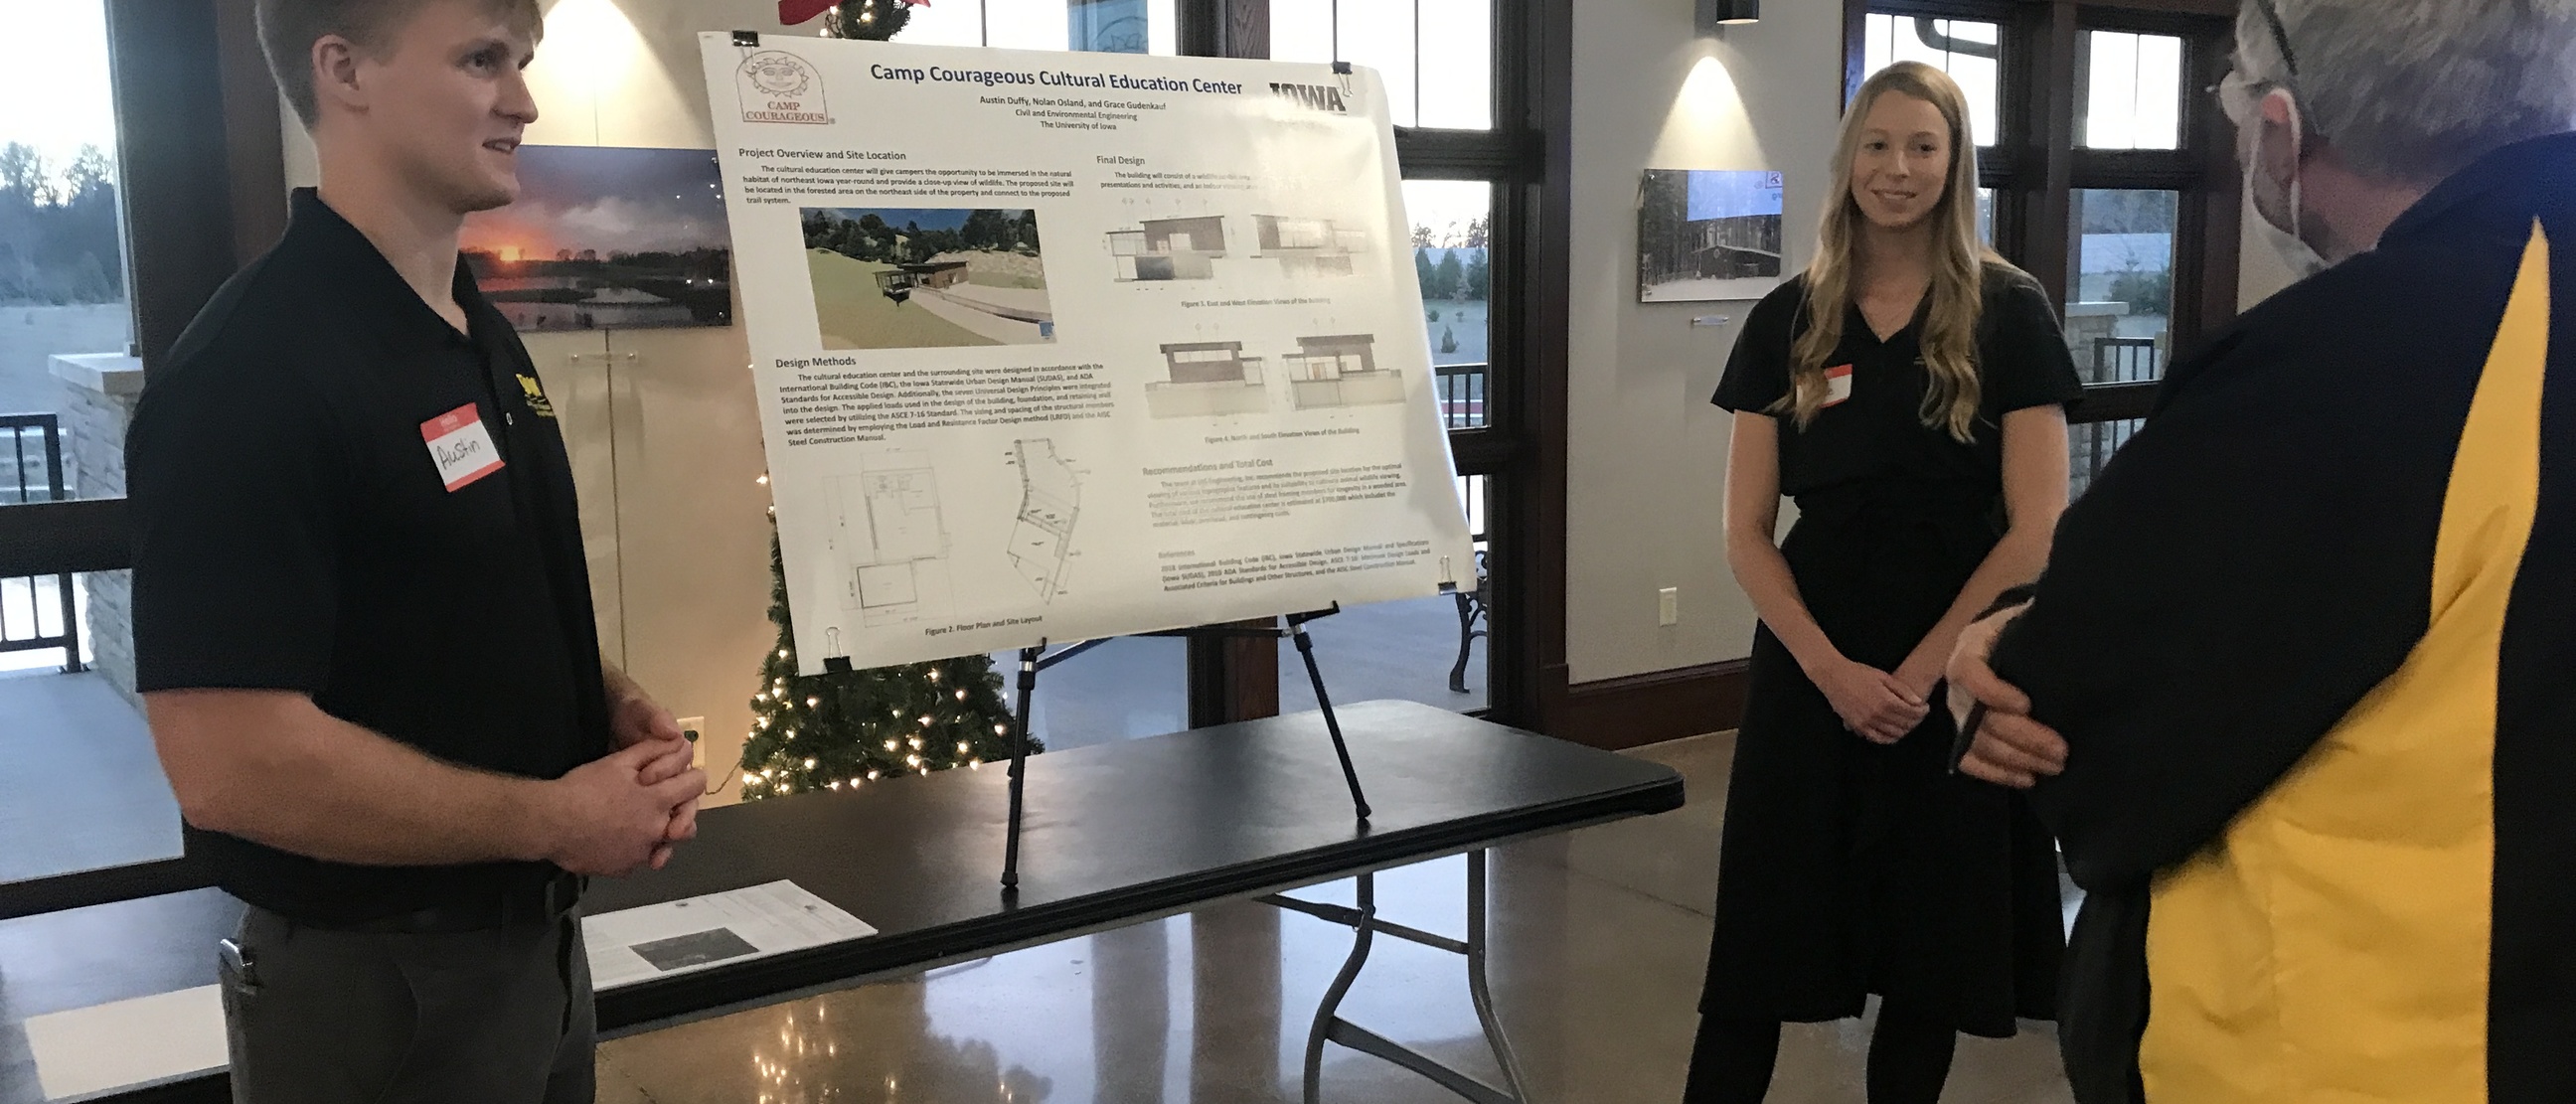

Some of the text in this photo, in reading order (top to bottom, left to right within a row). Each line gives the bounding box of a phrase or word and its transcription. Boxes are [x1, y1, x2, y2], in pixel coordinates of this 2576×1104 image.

[871, 64, 1242, 94] Camp Courageous Cultural Education Center
[767, 100, 800, 110] CAMP
[1008, 96, 1031, 106] Duffy,
[1033, 97, 1056, 106] Nolan
[1057, 98, 1086, 108] Osland,
[1088, 99, 1102, 108] and
[1127, 101, 1166, 110] Gudenkauf
[745, 110, 825, 121] COURAGEOUS
[1098, 111, 1138, 122] Engineering
[1055, 121, 1090, 130] University
[739, 148, 906, 160] Project Overview and Site Location
[1096, 155, 1145, 167] Final Design
[775, 357, 857, 370] Design Methods
[1003, 366, 1032, 375] designed
[780, 384, 828, 394] International
[781, 395, 819, 404] Standards
[806, 415, 837, 424] selected
[803, 425, 847, 434] determined
[788, 438, 807, 447] Steel
[809, 436, 856, 445] Construction
[437, 438, 480, 470] Austin
[925, 628, 947, 637] Figure
[992, 619, 1006, 628] and
[1021, 615, 1043, 625] Layout
